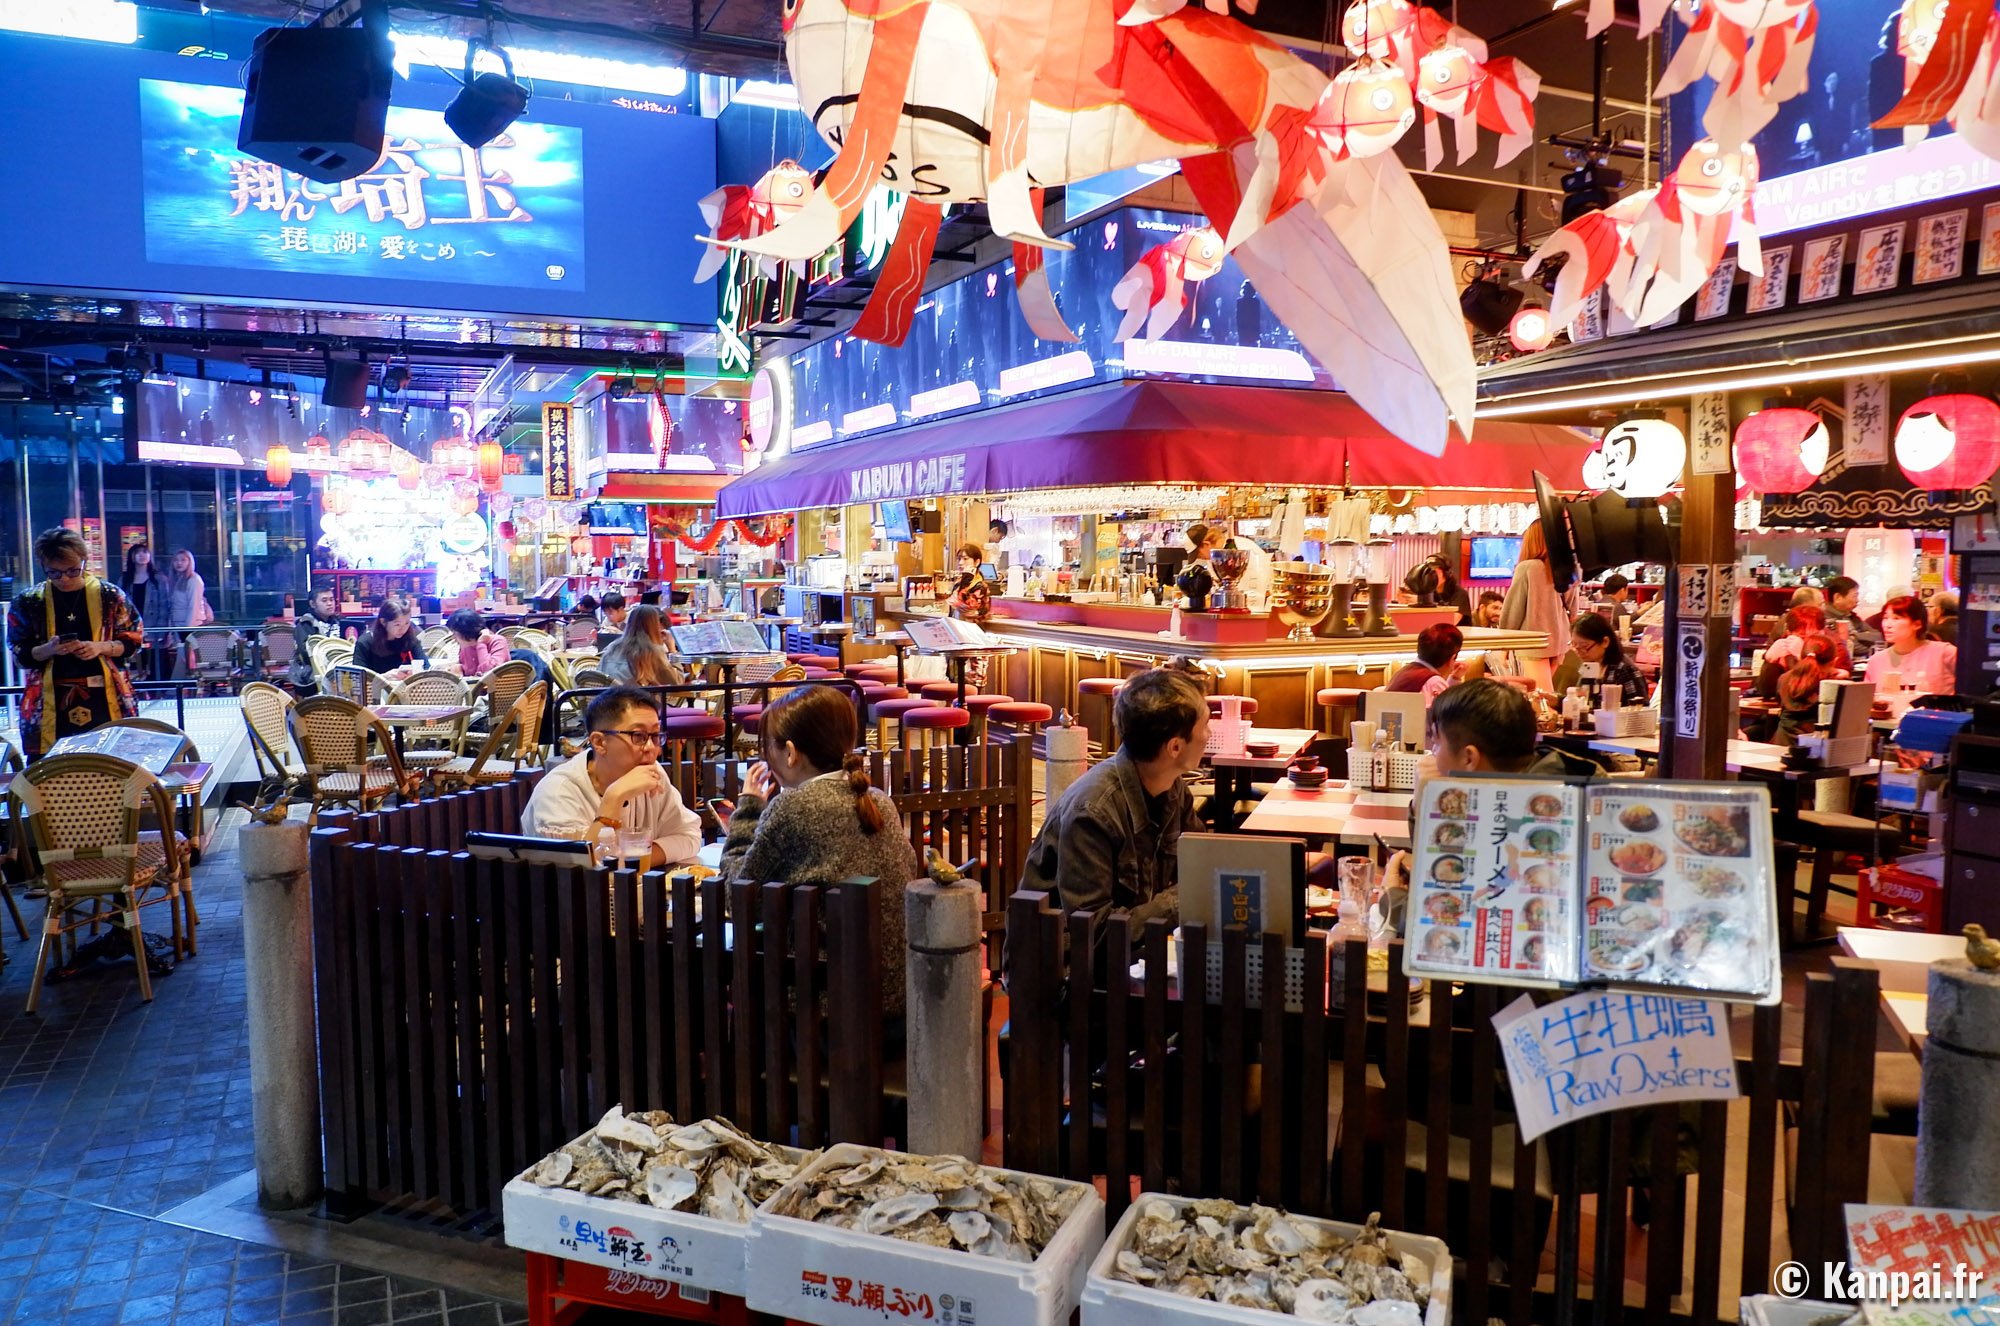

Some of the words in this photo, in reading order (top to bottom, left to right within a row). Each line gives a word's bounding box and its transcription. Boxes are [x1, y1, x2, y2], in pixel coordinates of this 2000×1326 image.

[850, 461, 912, 503] KABUKI
[916, 453, 966, 495] CAFE
[1545, 1069, 1623, 1116] Raw
[1611, 1046, 1731, 1094] Oysters
[831, 1276, 934, 1319] 黒瀬ぶり
